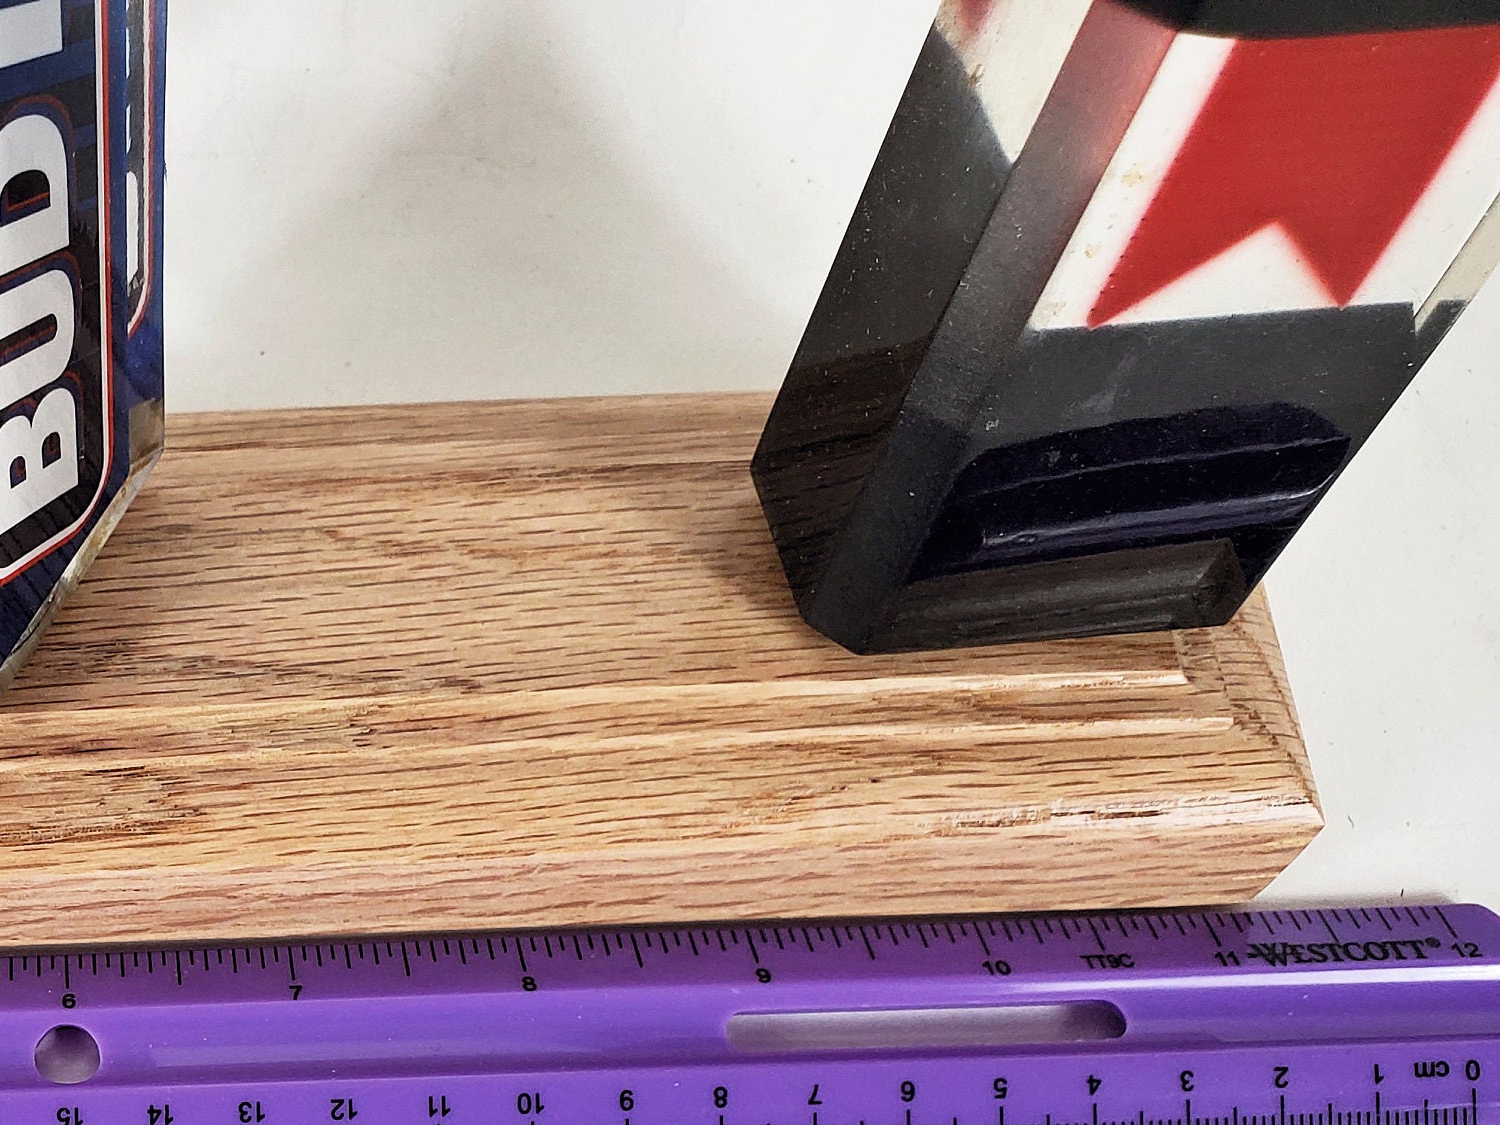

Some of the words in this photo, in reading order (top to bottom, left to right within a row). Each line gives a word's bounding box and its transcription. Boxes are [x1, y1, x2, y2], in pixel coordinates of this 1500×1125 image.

[1214, 950, 1241, 968] 11
[1450, 942, 1484, 959] 12
[61, 993, 77, 1009] 6
[288, 984, 303, 1001] 7
[521, 975, 538, 992] 8
[754, 967, 772, 984] 9
[981, 959, 1012, 976] 10
[238, 1100, 266, 1124] 13
[330, 1098, 358, 1121] 12
[428, 1095, 452, 1119] 11
[516, 1092, 546, 1115] 10
[619, 1089, 635, 1112] 9
[712, 1085, 729, 1109] 8
[807, 1083, 823, 1106] 7
[899, 1080, 916, 1103] 6
[992, 1077, 1008, 1100] 5
[1085, 1073, 1103, 1097] 4
[1179, 1069, 1195, 1093] 3
[1272, 1066, 1289, 1089] 2
[1373, 1063, 1385, 1086] 1
[1412, 1060, 1450, 1079] cm
[1464, 1059, 1481, 1082] 0
